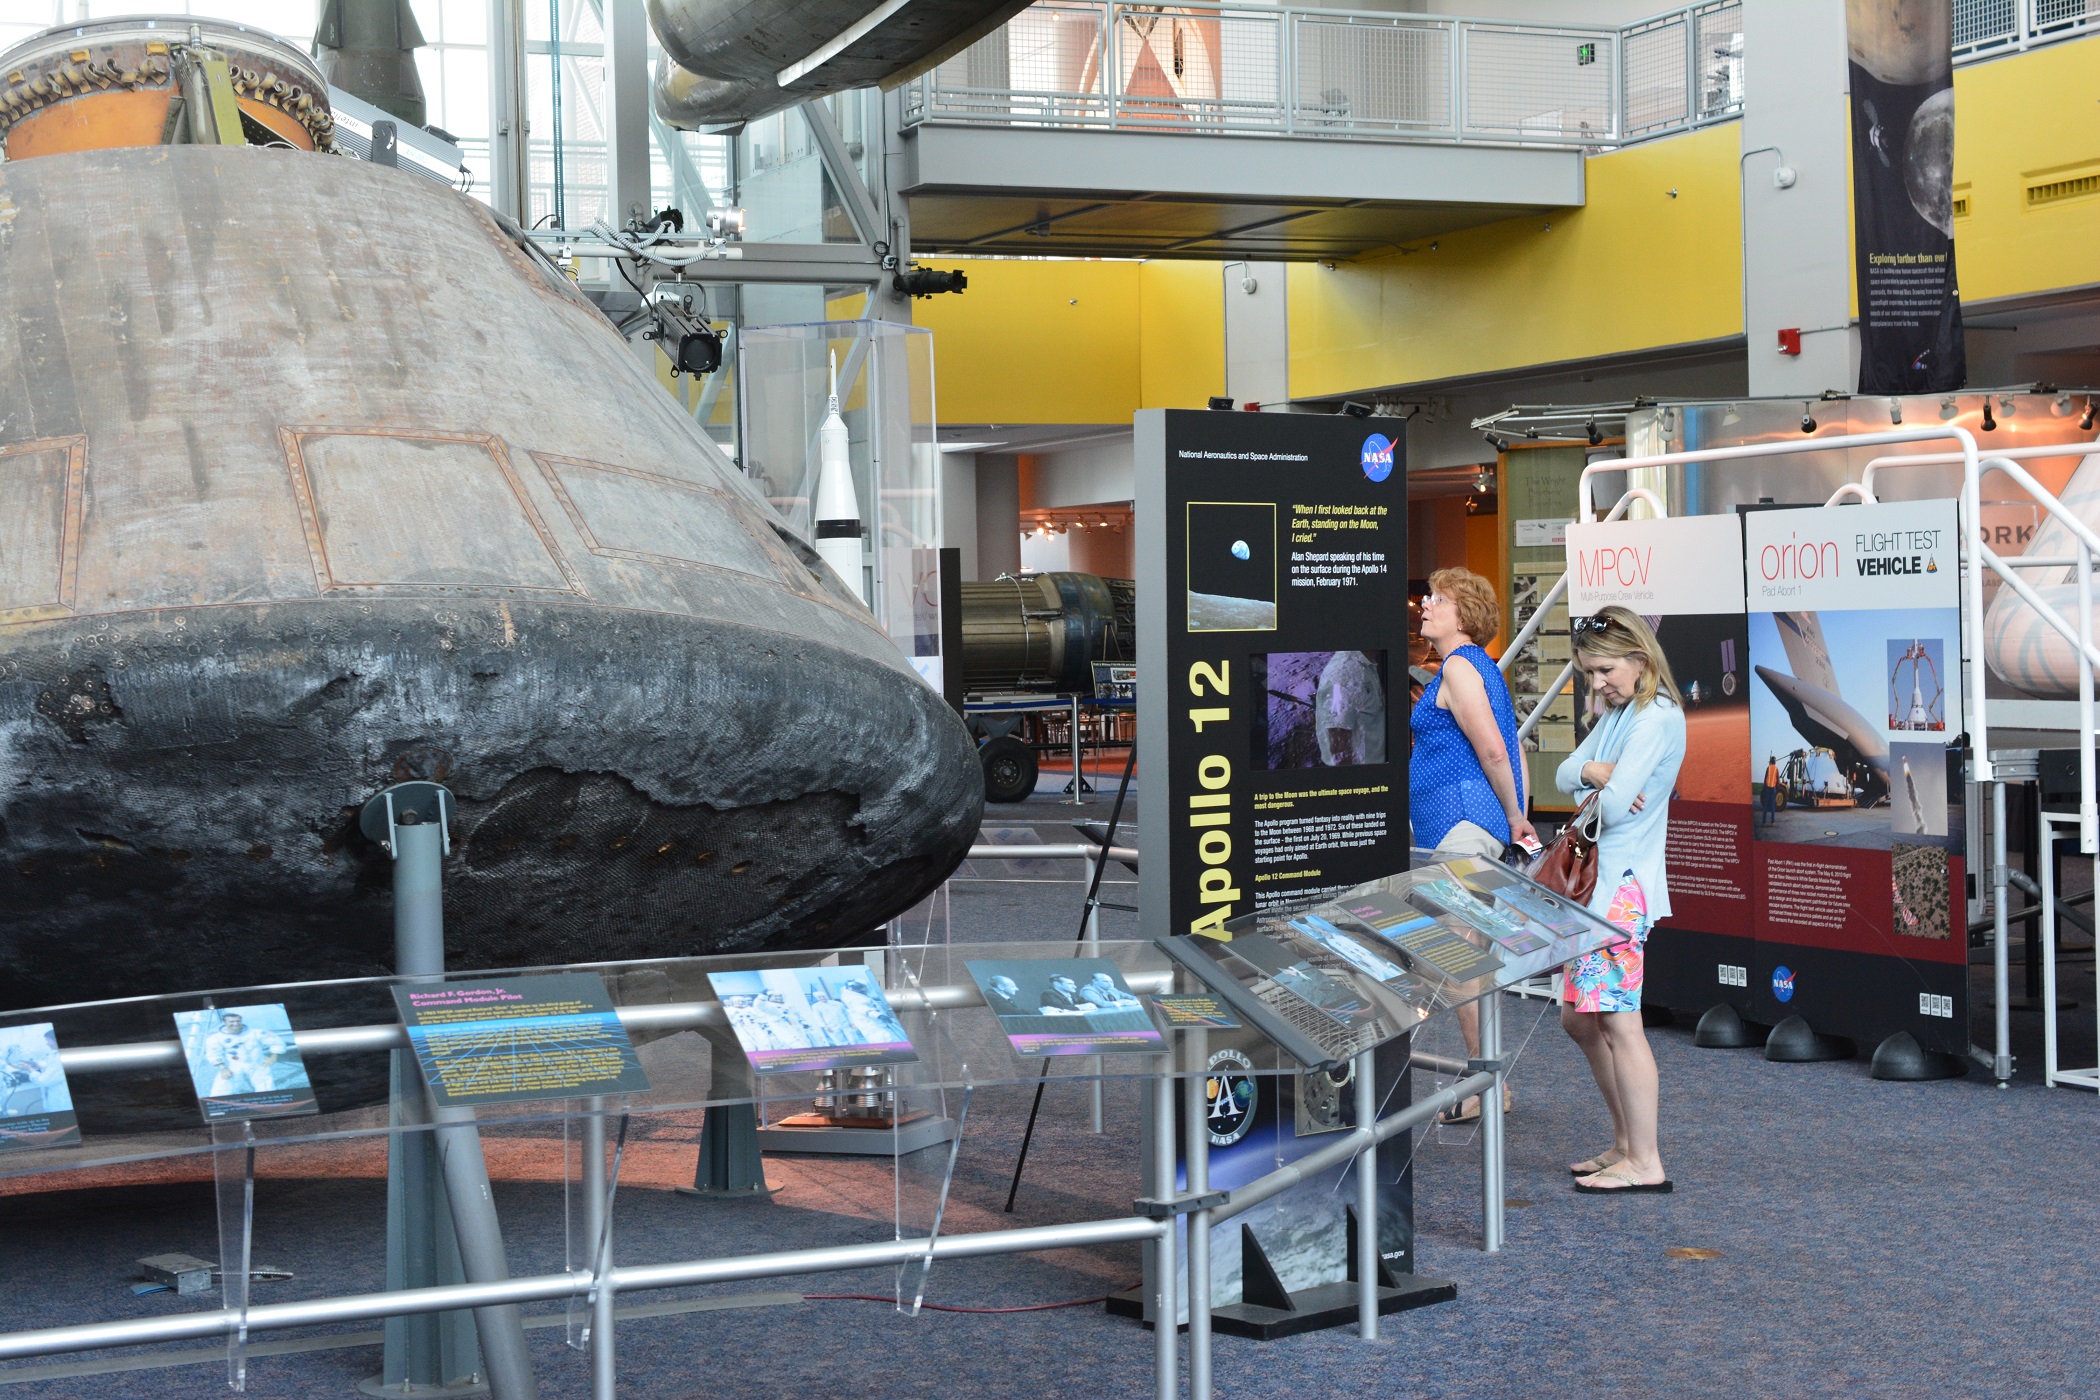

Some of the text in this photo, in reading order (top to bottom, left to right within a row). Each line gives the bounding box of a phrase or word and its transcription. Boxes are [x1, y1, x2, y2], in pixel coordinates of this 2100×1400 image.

[1870, 252, 1945, 266] Exploring farther than ever
[1179, 450, 1202, 458] National
[1204, 451, 1237, 459] Aeronautics
[1250, 452, 1268, 462] Space
[1269, 452, 1308, 461] Administration
[1364, 452, 1392, 463] NASA
[1314, 505, 1317, 514] I
[1318, 505, 1332, 514] first
[1332, 505, 1353, 514] looked
[1354, 506, 1369, 514] back
[1370, 506, 1376, 514] at
[1377, 506, 1387, 515] the
[1292, 519, 1310, 530] Earth,
[1312, 519, 1338, 530] standing
[1349, 520, 1359, 528] the
[1360, 520, 1378, 531] Moon,
[1292, 533, 1295, 542] I
[1856, 530, 1941, 552] FLIGHT TEST
[1291, 552, 1384, 563] Alan Shepard speaking of his time
[1761, 532, 1838, 580] orion
[1300, 565, 1309, 573] the
[1311, 565, 1331, 573] surface
[1333, 565, 1350, 575] during
[1352, 565, 1360, 573] the
[1361, 565, 1378, 575] Apollo
[1380, 565, 1387, 573] 14
[1580, 546, 1651, 587] MPCV
[1857, 556, 1922, 576] VEHICLE
[1292, 577, 1358, 588] mission, February 1971.
[1580, 590, 1653, 602] Multi-Purpose Crew Vehicle
[1762, 585, 1802, 596] Pad Abort 1
[1189, 660, 1240, 942] Apollo 12
[1268, 801, 1294, 809] dangerous.
[1264, 819, 1278, 828] Apollo
[1315, 816, 1330, 824] fantasy
[1355, 831, 1373, 839] previous
[1255, 856, 1273, 864] starting
[1255, 874, 1271, 882] Apollo
[1266, 891, 1280, 899] Apollo
[1281, 889, 1303, 897] command
[1774, 979, 1793, 990] NASA
[410, 991, 446, 1000] Richard
[412, 999, 462, 1007] Command
[1208, 1049, 1251, 1070] POLLO
[1211, 1132, 1240, 1144] NASA
